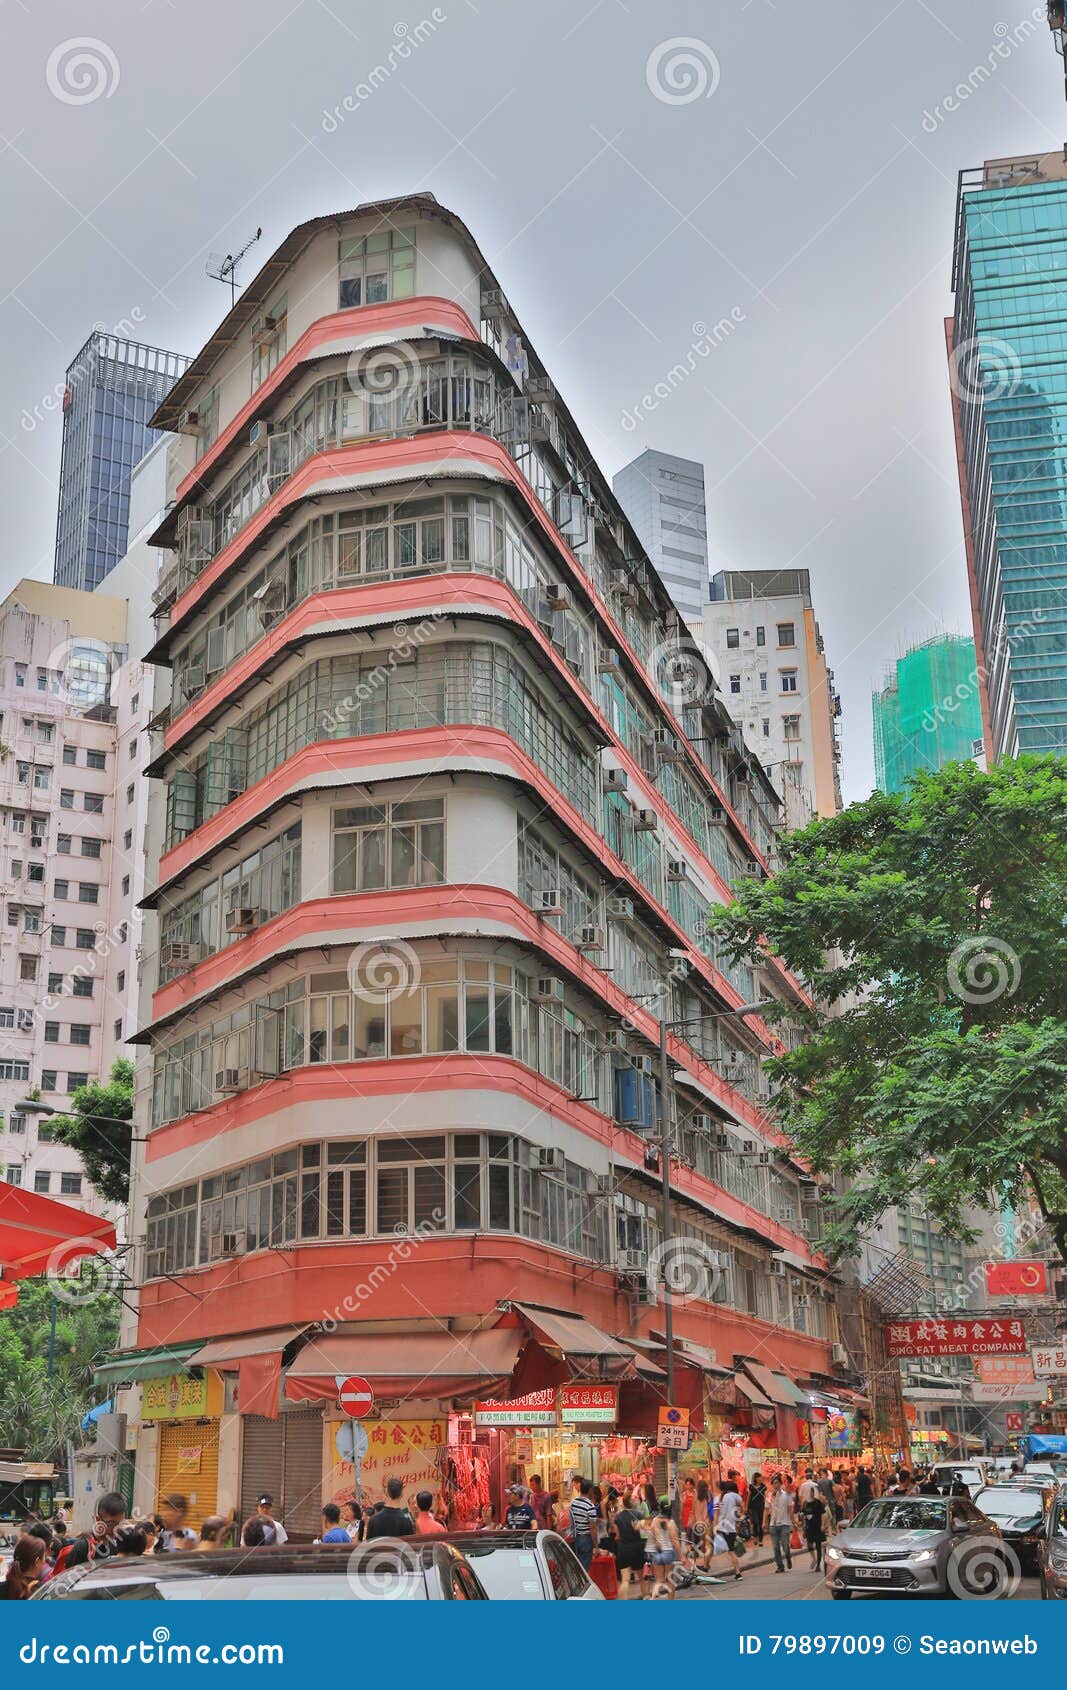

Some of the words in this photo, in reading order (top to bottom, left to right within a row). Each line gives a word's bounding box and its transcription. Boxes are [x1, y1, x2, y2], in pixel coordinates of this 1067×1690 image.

[889, 1346, 913, 1355] SING
[917, 1345, 935, 1354] FAT
[940, 1344, 968, 1353] MEAT
[972, 1342, 1023, 1352] COMPANY
[673, 1428, 685, 1436] hrs
[662, 1436, 682, 1446] 全日
[337, 1456, 377, 1476] Frsh
[383, 1448, 410, 1467] and
